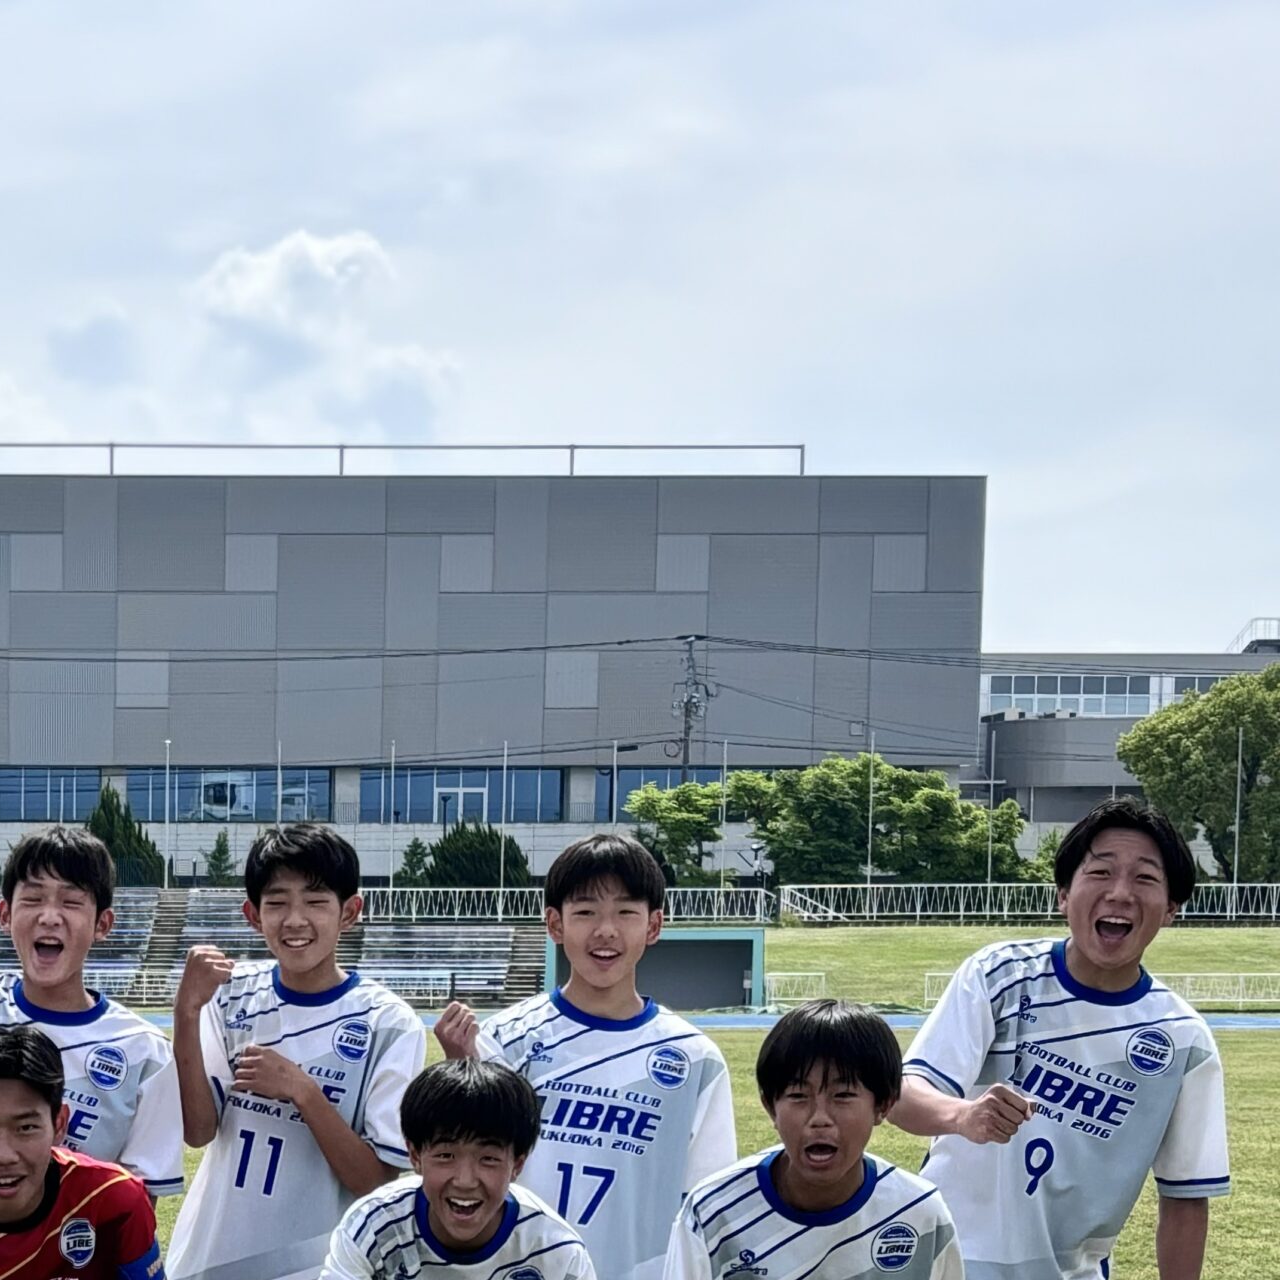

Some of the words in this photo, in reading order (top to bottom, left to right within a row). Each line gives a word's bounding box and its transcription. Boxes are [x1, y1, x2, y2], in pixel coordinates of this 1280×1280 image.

[308, 1066, 346, 1081] CLUB
[1019, 1041, 1092, 1078] FOOTBALL
[1096, 1072, 1137, 1092] CLUB
[543, 1080, 620, 1100] FOOTBALL
[625, 1091, 662, 1108] CLUB
[1007, 1055, 1136, 1127] LIBRE
[540, 1129, 603, 1148] UKUOKA
[611, 1139, 645, 1155] 2016
[541, 1096, 662, 1142] LIBRE
[1070, 1118, 1112, 1140] 2016
[234, 1129, 285, 1197] 11
[1025, 1137, 1055, 1196] 9
[557, 1162, 616, 1226] 17
[876, 1244, 916, 1255] LIBRE
